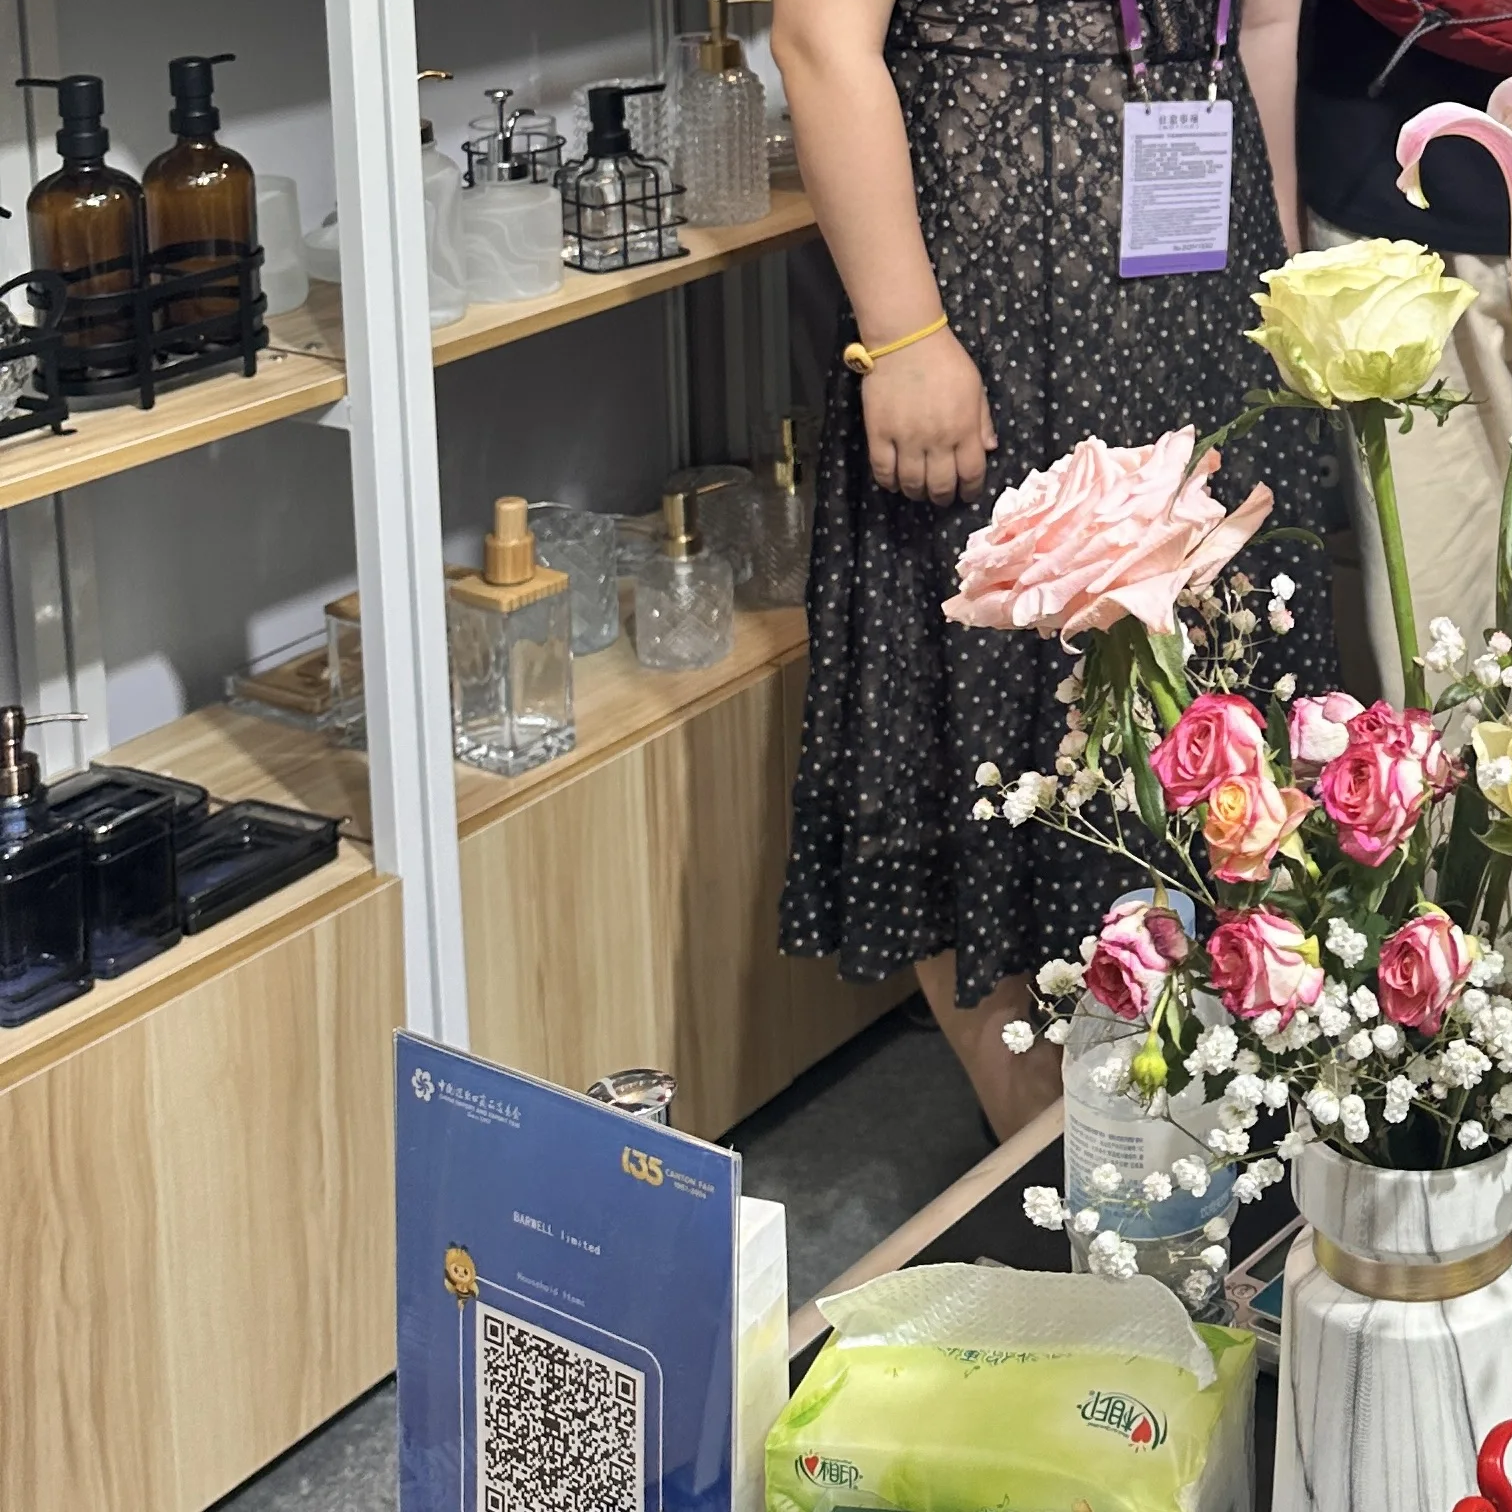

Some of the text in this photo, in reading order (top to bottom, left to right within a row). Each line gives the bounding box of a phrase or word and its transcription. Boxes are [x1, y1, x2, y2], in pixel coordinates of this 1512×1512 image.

[622, 1146, 664, 1187] 135
[664, 1168, 697, 1186] CANTON
[560, 1229, 601, 1256] limited
